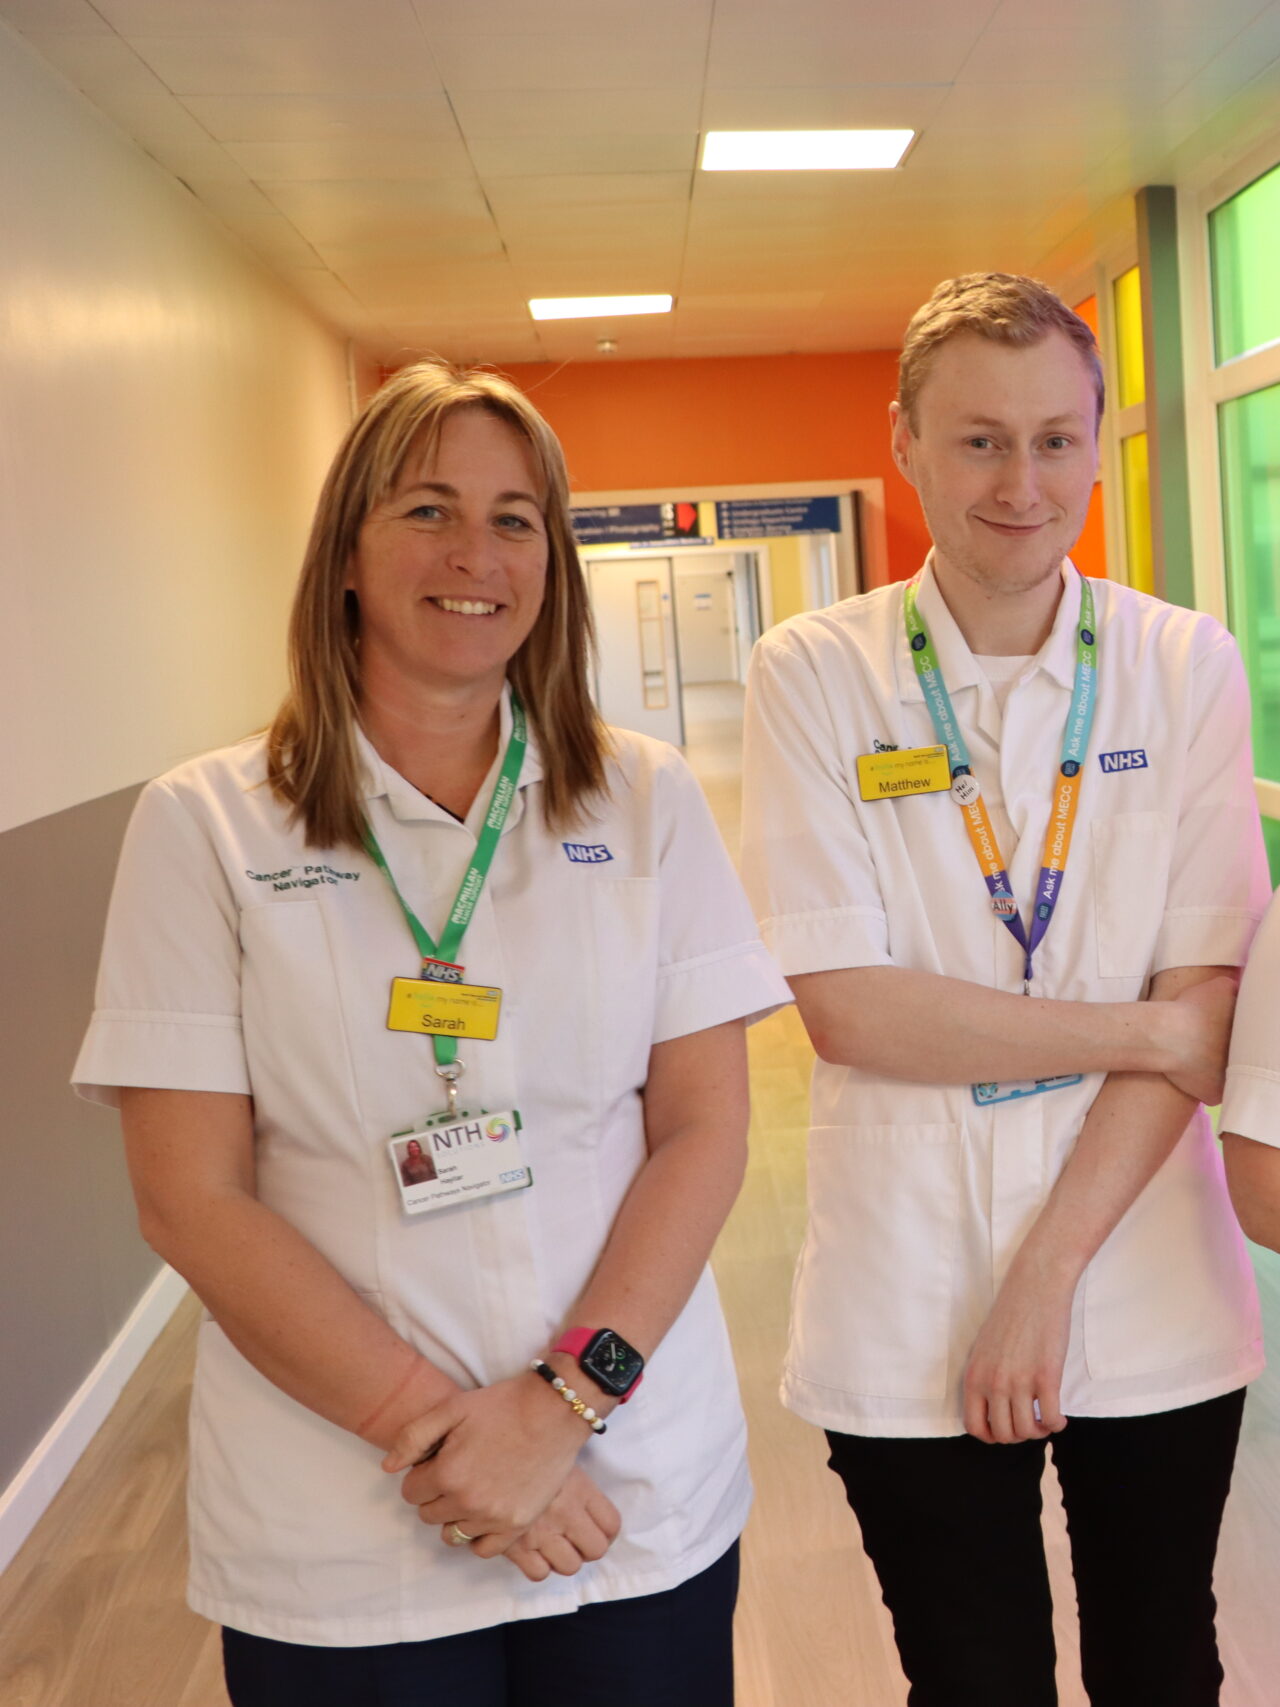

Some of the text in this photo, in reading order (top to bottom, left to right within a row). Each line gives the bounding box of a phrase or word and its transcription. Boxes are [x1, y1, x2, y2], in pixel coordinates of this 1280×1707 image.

[920, 656, 938, 688] MECC
[1081, 651, 1092, 683] MECC
[931, 686, 949, 721] about
[1077, 683, 1091, 716] about
[943, 722, 956, 739] me
[1073, 717, 1085, 735] me
[948, 739, 963, 762] Ask
[1068, 736, 1082, 757] Ask
[1104, 751, 1145, 772] NHS
[878, 778, 931, 793] Matthew
[960, 787, 974, 800] Him
[1057, 785, 1073, 819] MECC
[968, 801, 984, 826] MEC
[976, 826, 995, 861] about
[1052, 822, 1067, 856] about
[567, 845, 609, 861] NHS
[245, 869, 292, 882] Cancer
[989, 862, 1001, 880] me
[1050, 858, 1061, 876] me
[451, 867, 479, 925] MACMILLAN
[1043, 878, 1056, 899] Ask
[992, 902, 1014, 914] Ally
[427, 963, 460, 982] NHS
[421, 1014, 466, 1031] Sarah
[432, 1122, 483, 1151] NTH
